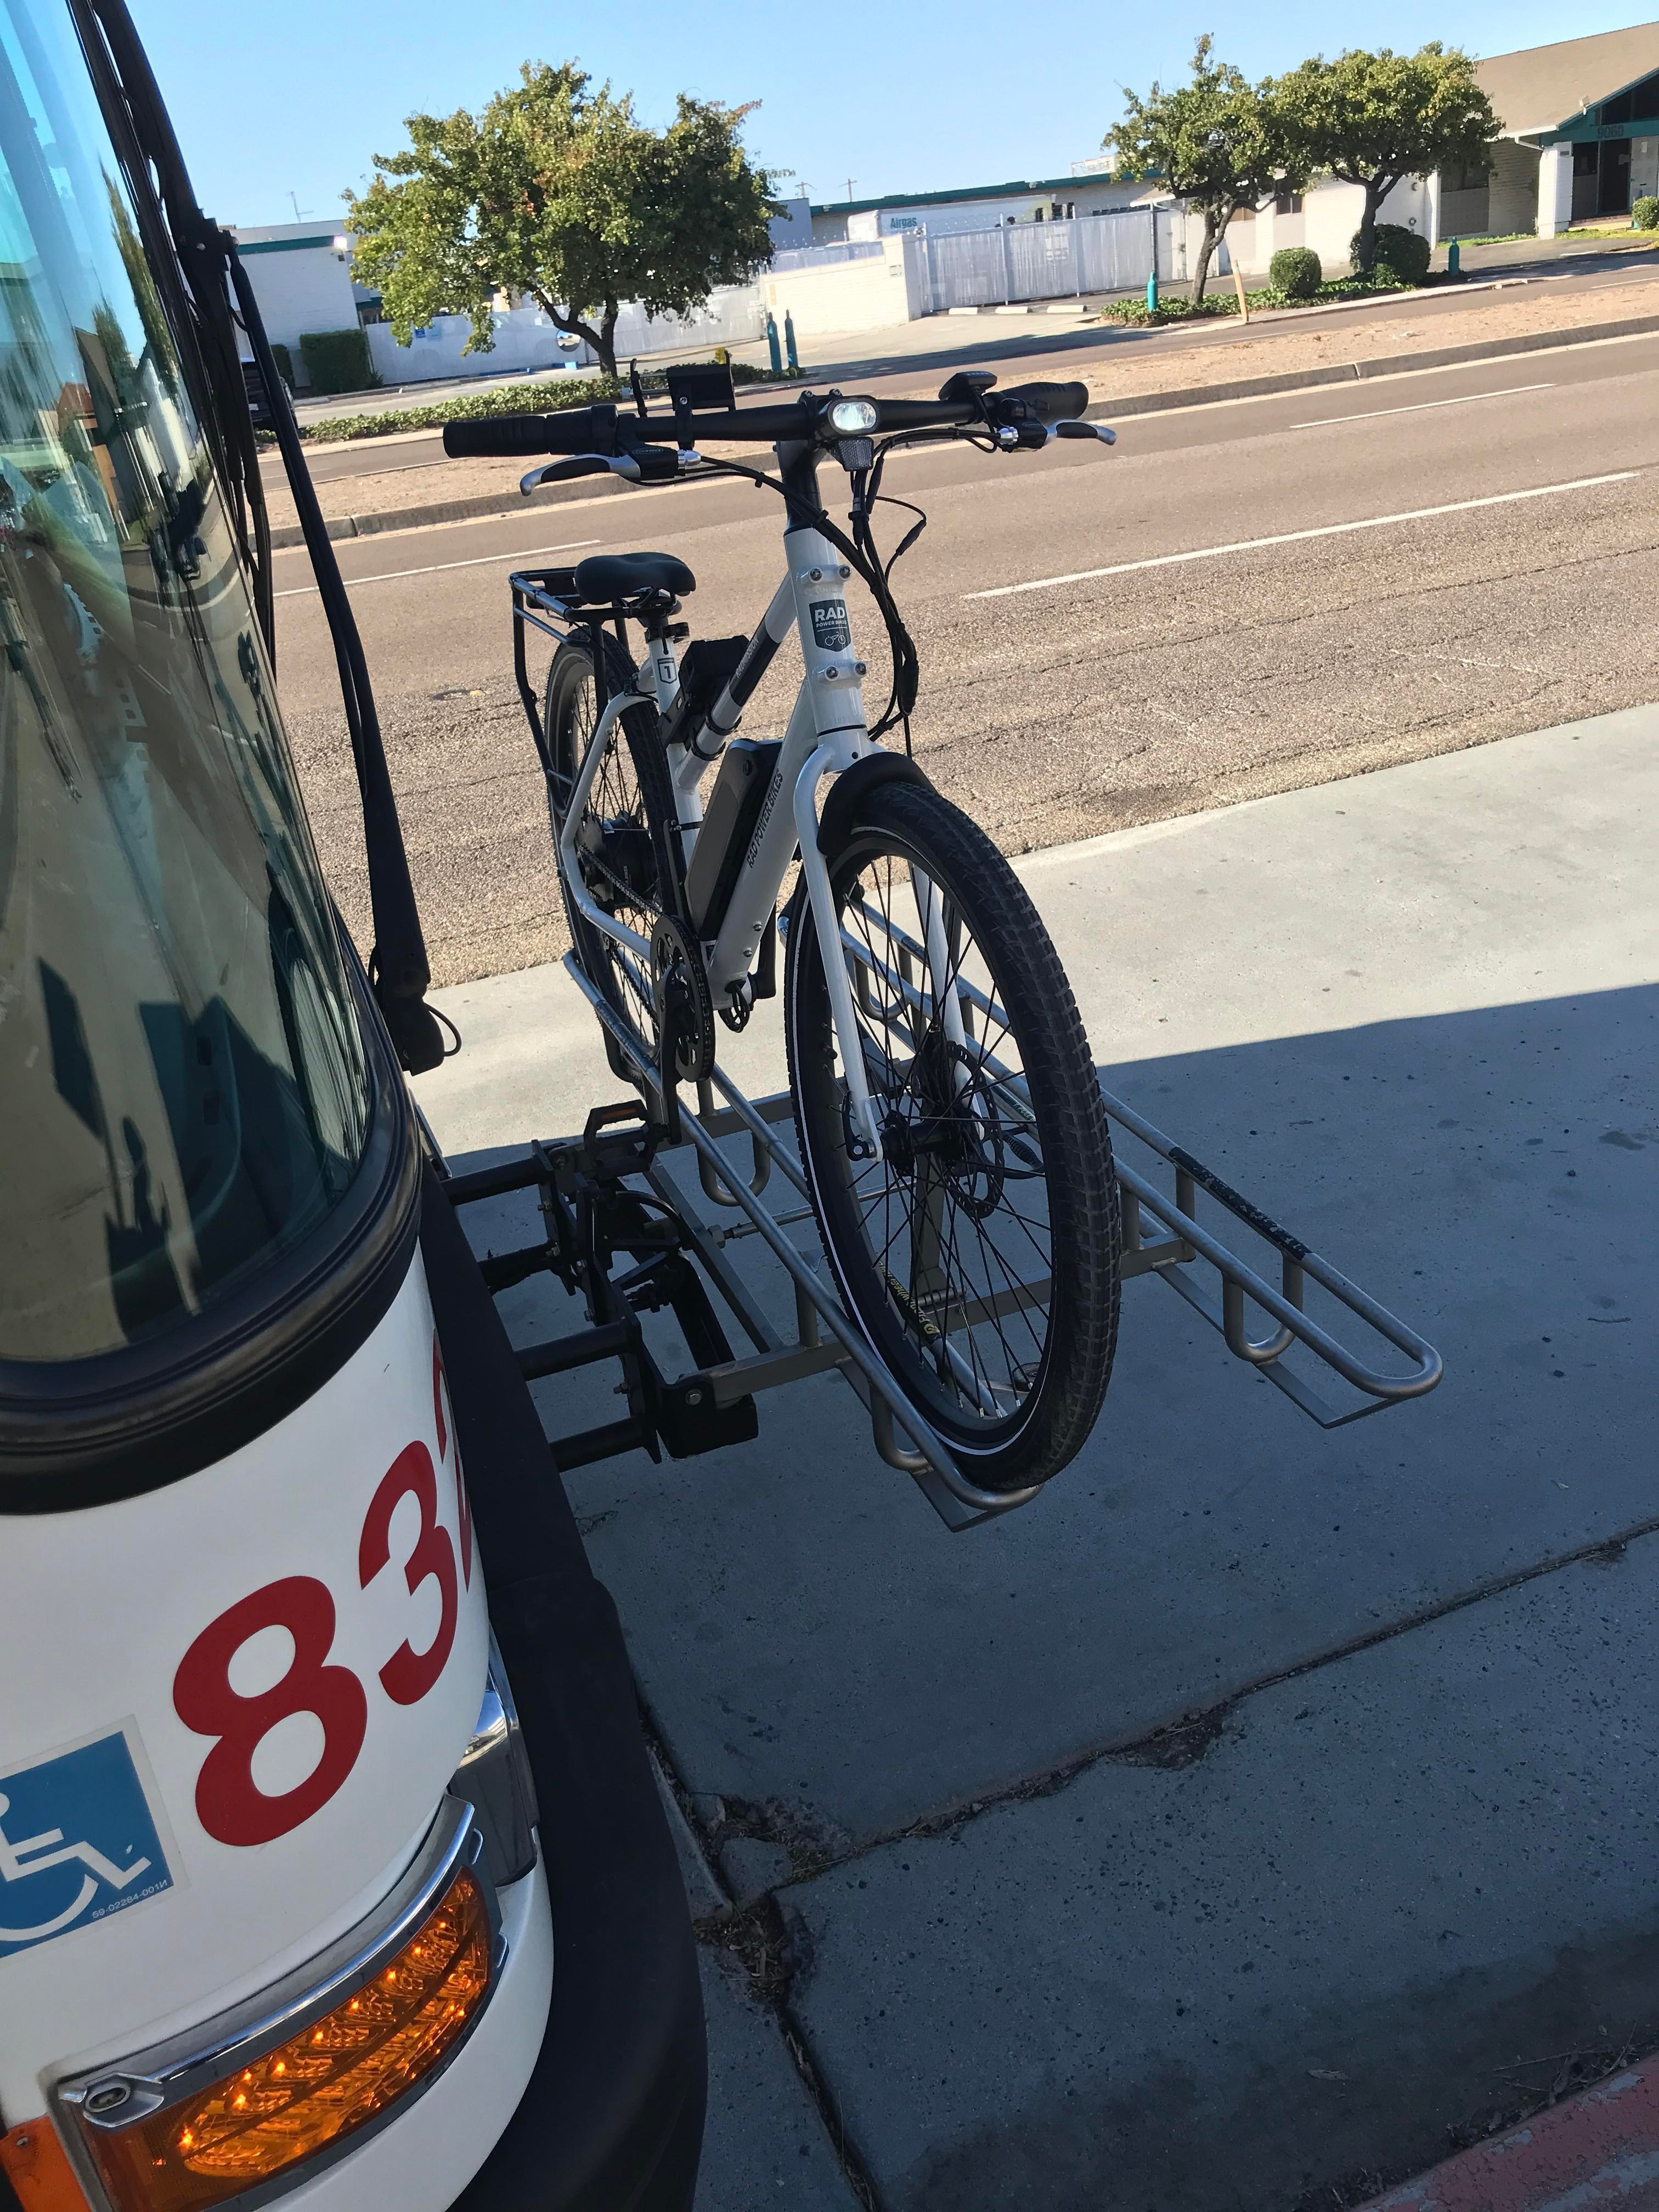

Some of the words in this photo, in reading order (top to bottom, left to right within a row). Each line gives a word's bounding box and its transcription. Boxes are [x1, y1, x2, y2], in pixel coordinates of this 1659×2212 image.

[890, 217, 918, 229] Airgas
[815, 607, 845, 622] RAD
[747, 841, 758, 868] RAD
[755, 802, 772, 847] POWER
[768, 768, 784, 808] BIKES
